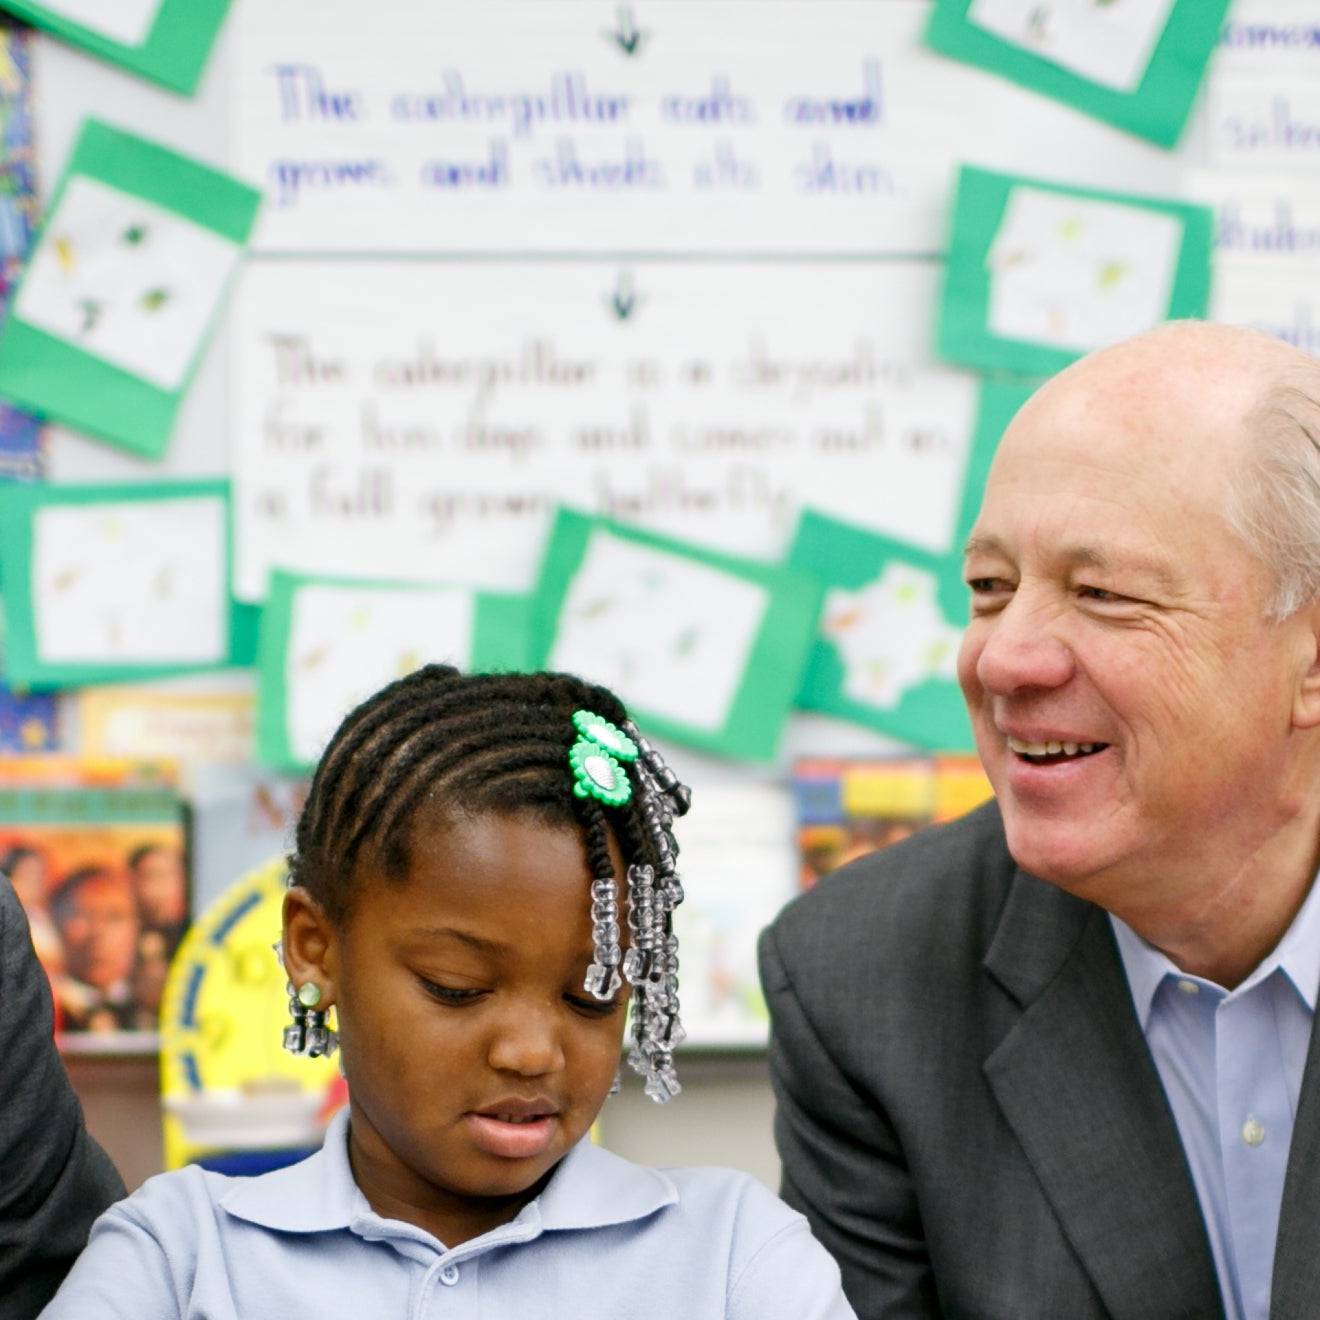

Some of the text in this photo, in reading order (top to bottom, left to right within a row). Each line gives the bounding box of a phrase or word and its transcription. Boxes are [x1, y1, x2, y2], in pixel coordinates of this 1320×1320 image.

[272, 65, 362, 123] The
[785, 55, 883, 125] and
[420, 138, 508, 187] and
[262, 332, 345, 386] The
[683, 358, 711, 386] a
[263, 396, 325, 450] for
[573, 400, 650, 452] and
[255, 488, 287, 521] a
[310, 462, 392, 516] full
